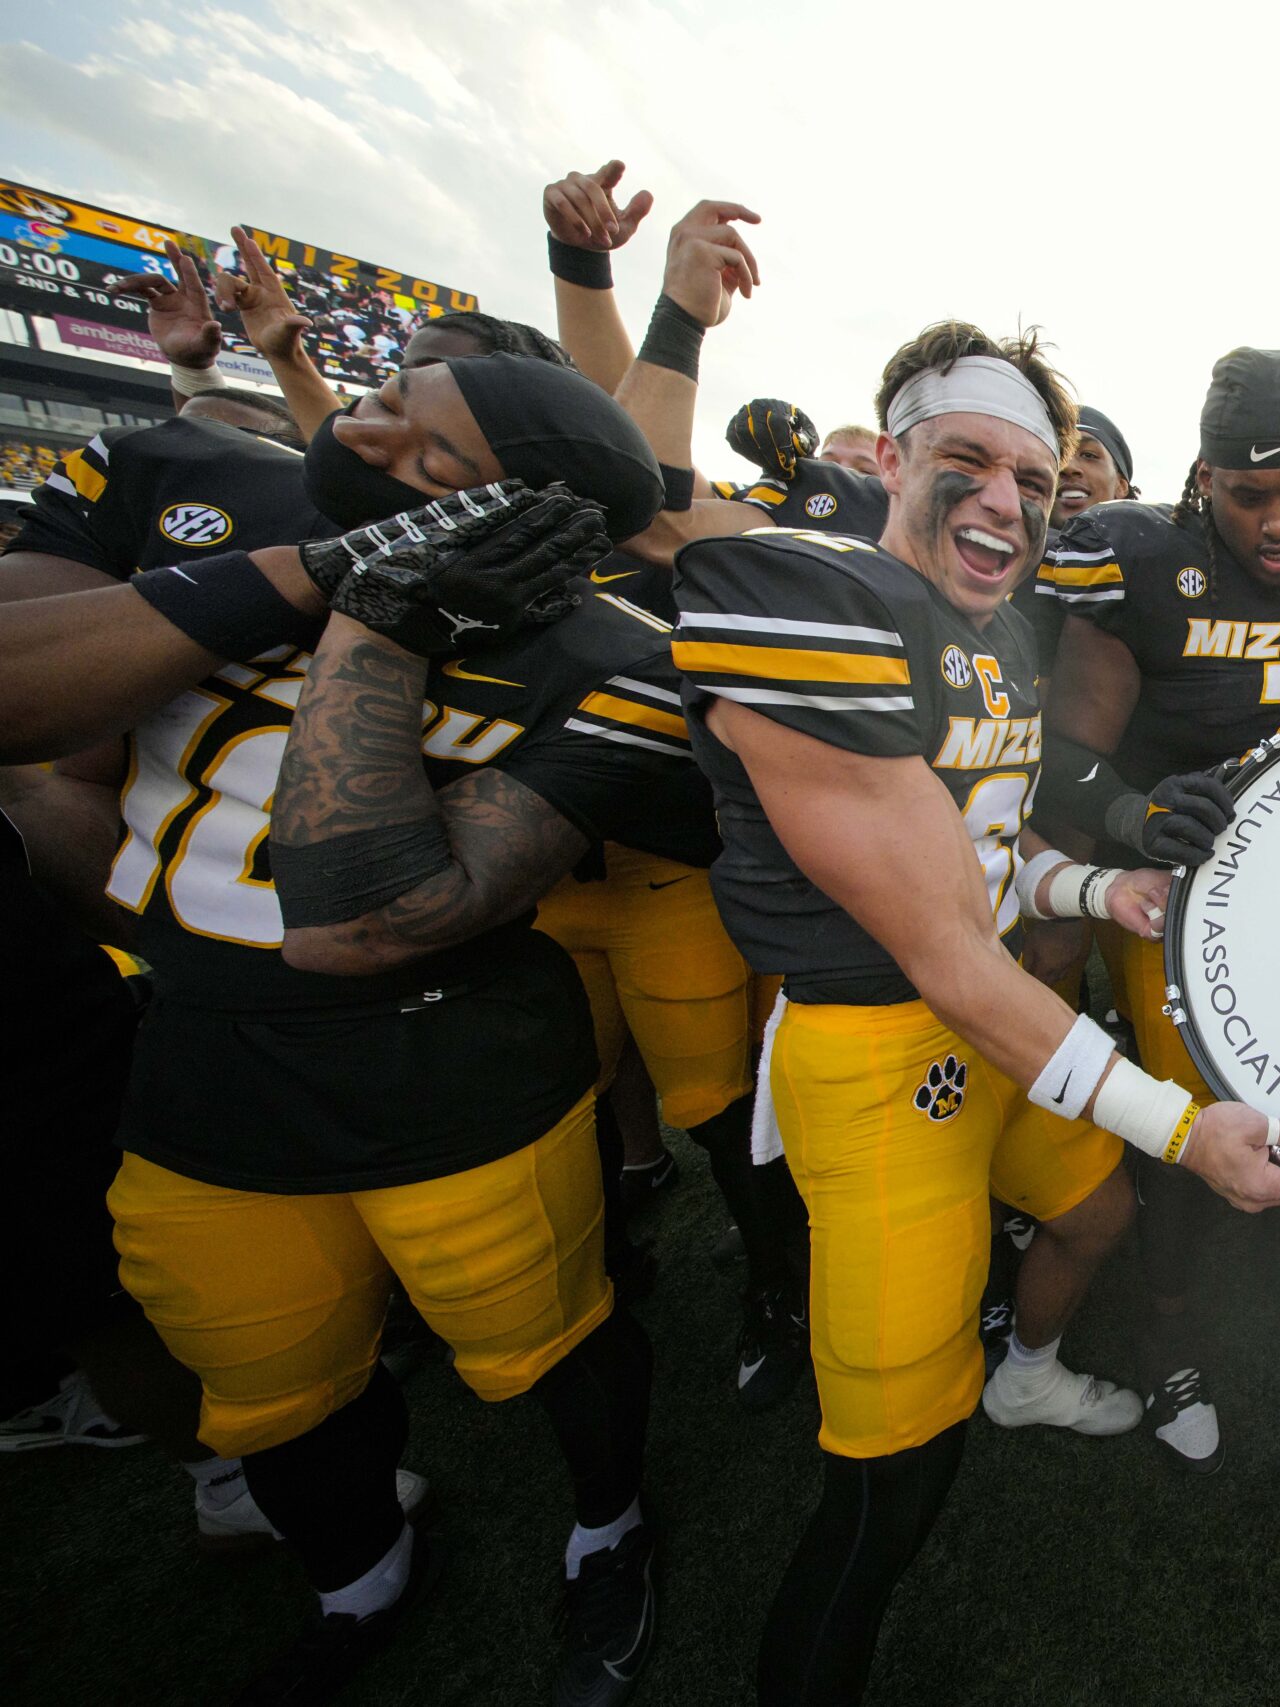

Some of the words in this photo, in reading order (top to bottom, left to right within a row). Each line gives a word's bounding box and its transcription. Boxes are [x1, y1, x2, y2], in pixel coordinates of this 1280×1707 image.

[133, 227, 171, 251] 42
[141, 254, 179, 281] 31
[252, 228, 478, 312] MIZZOU
[15, 273, 60, 293] 2ND
[63, 285, 81, 298] &
[85, 291, 110, 306] 10
[113, 296, 142, 313] ON
[216, 359, 273, 378] eakTime
[807, 495, 834, 516] SEC
[163, 505, 227, 543] SEC
[1179, 569, 1204, 596] SEC
[944, 648, 972, 688] SEC
[972, 653, 1010, 719] C
